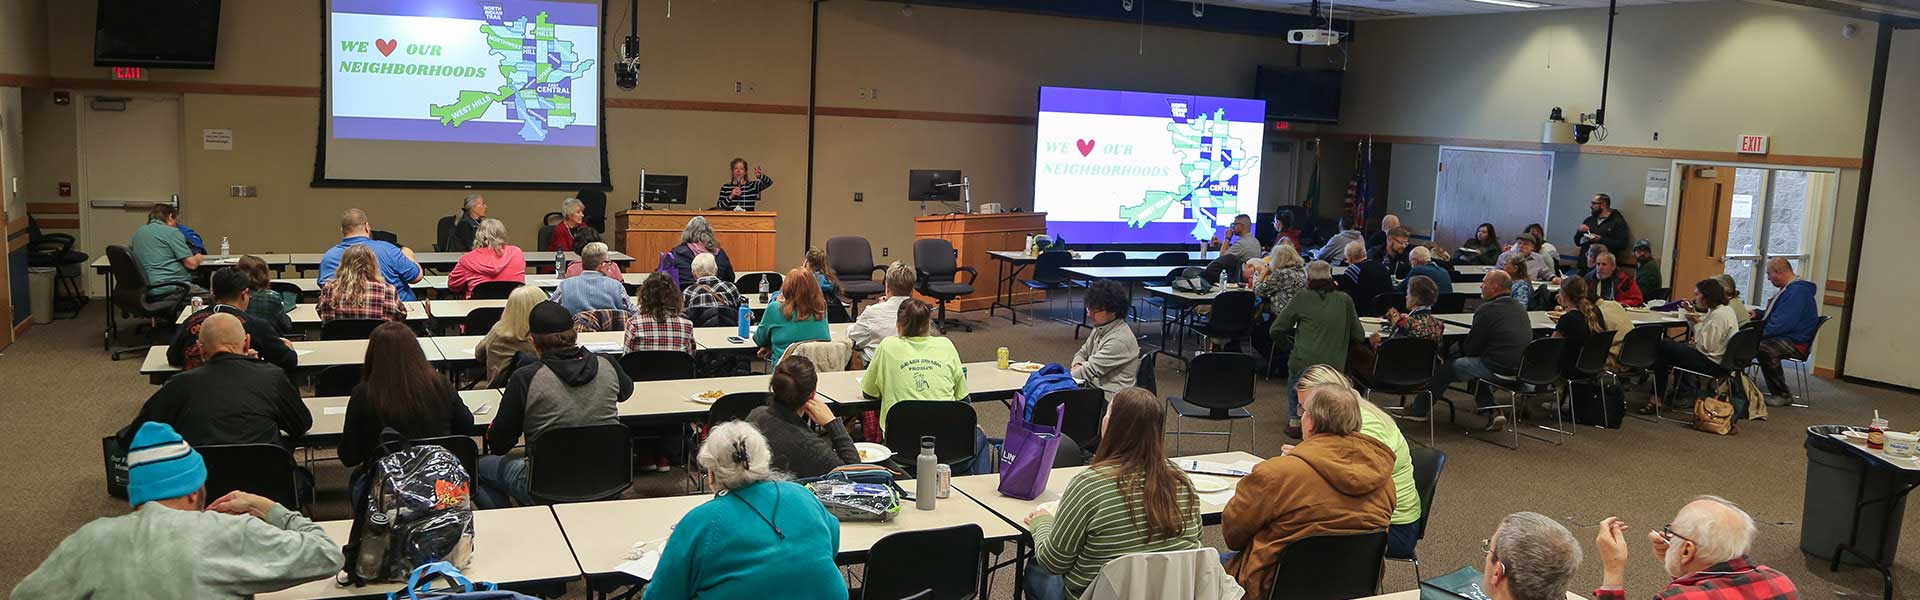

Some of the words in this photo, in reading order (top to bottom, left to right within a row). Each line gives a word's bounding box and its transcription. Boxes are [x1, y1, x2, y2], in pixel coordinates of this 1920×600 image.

[340, 40, 369, 53] WE
[406, 43, 442, 56] OUR
[339, 61, 487, 78] NEIGHBORHOODS
[536, 86, 571, 94] CENTRAL
[450, 104, 472, 119] WEST
[471, 95, 491, 109] HILLS
[1045, 141, 1072, 154] WE
[1103, 143, 1134, 156] OUR
[1743, 136, 1763, 151] EXIT
[1044, 163, 1170, 177] NEIGHBORHOODS
[1210, 184, 1239, 192] CENTRAL
